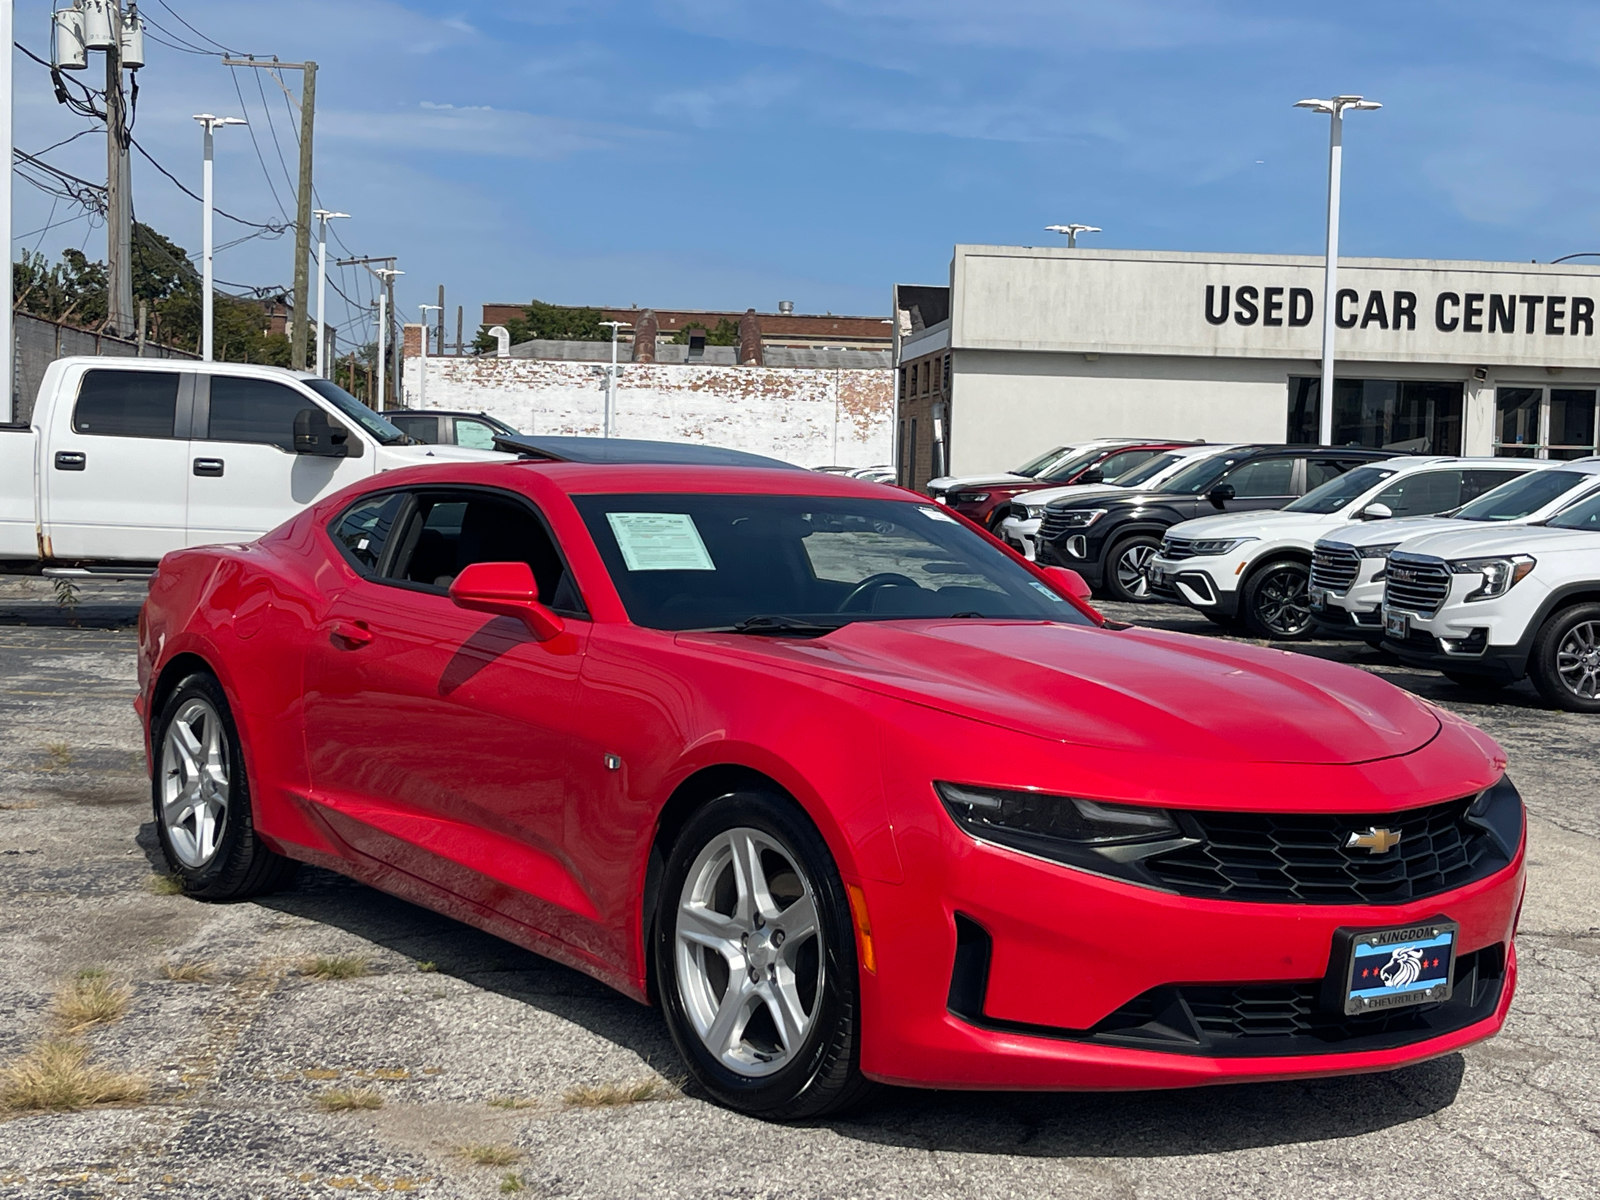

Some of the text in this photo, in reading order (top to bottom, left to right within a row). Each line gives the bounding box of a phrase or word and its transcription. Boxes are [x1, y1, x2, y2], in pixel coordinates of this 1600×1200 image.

[1204, 284, 1596, 337] USED CAR CENTER
[1378, 926, 1435, 943] KINGDOM
[1368, 991, 1425, 1008] CHEVROLET
